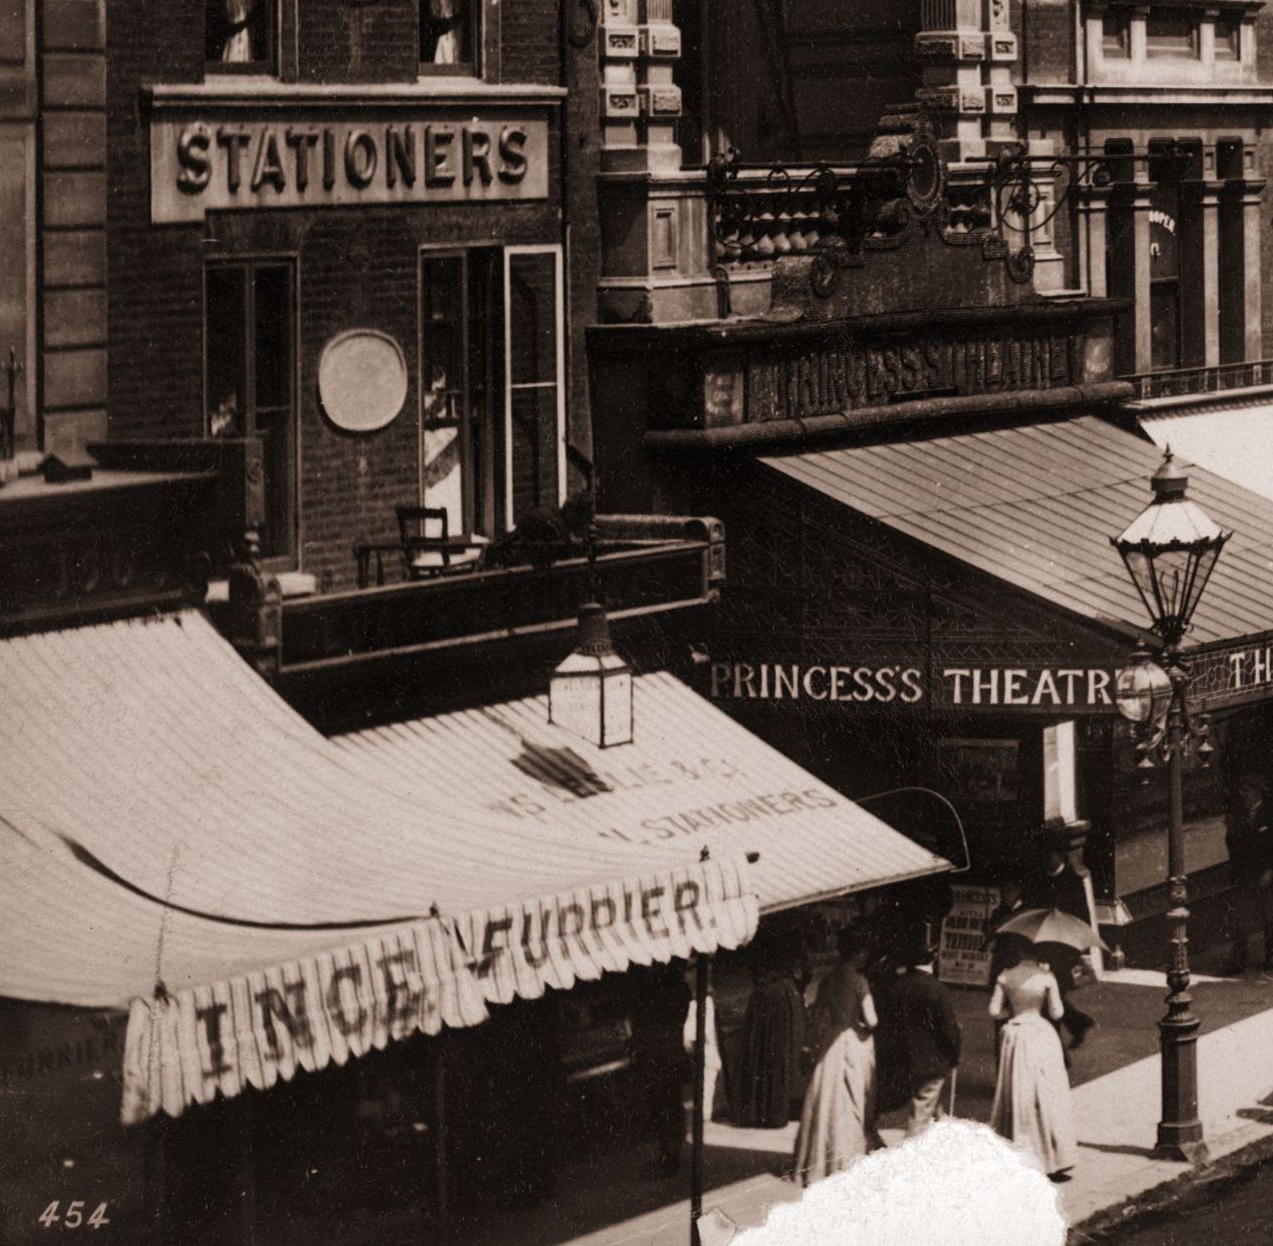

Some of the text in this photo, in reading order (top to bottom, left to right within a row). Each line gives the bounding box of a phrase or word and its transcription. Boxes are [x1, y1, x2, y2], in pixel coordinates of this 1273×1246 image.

[174, 120, 530, 194] STATIONERS
[708, 663, 923, 703] PRINCESS'S
[541, 764, 674, 804] LLIE
[640, 788, 838, 841] STATIONERS
